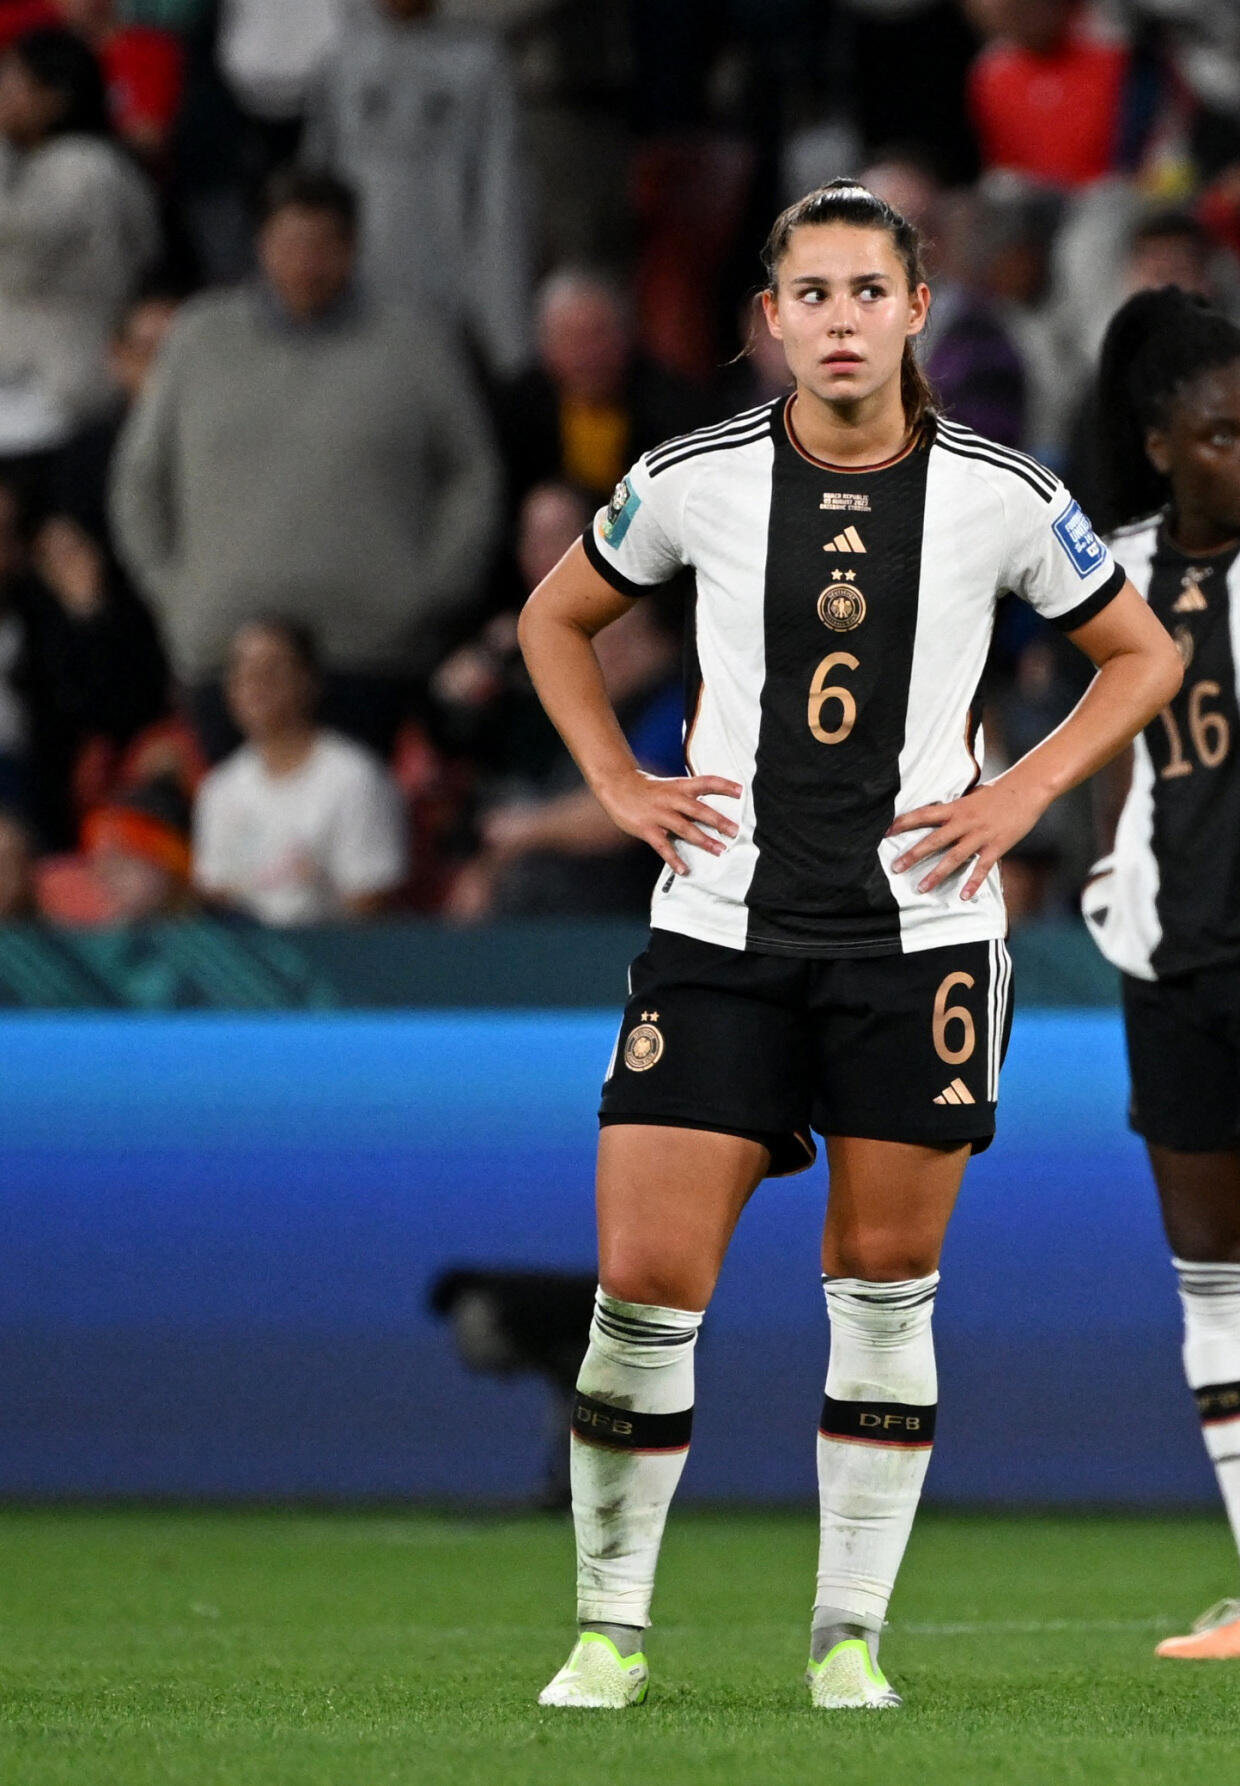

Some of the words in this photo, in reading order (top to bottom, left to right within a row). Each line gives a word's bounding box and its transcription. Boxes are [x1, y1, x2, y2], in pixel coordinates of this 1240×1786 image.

[807, 651, 860, 745] 6
[1160, 679, 1231, 780] 16
[932, 971, 976, 1065] 6
[576, 1405, 633, 1435] DFB
[859, 1412, 921, 1431] DFB
